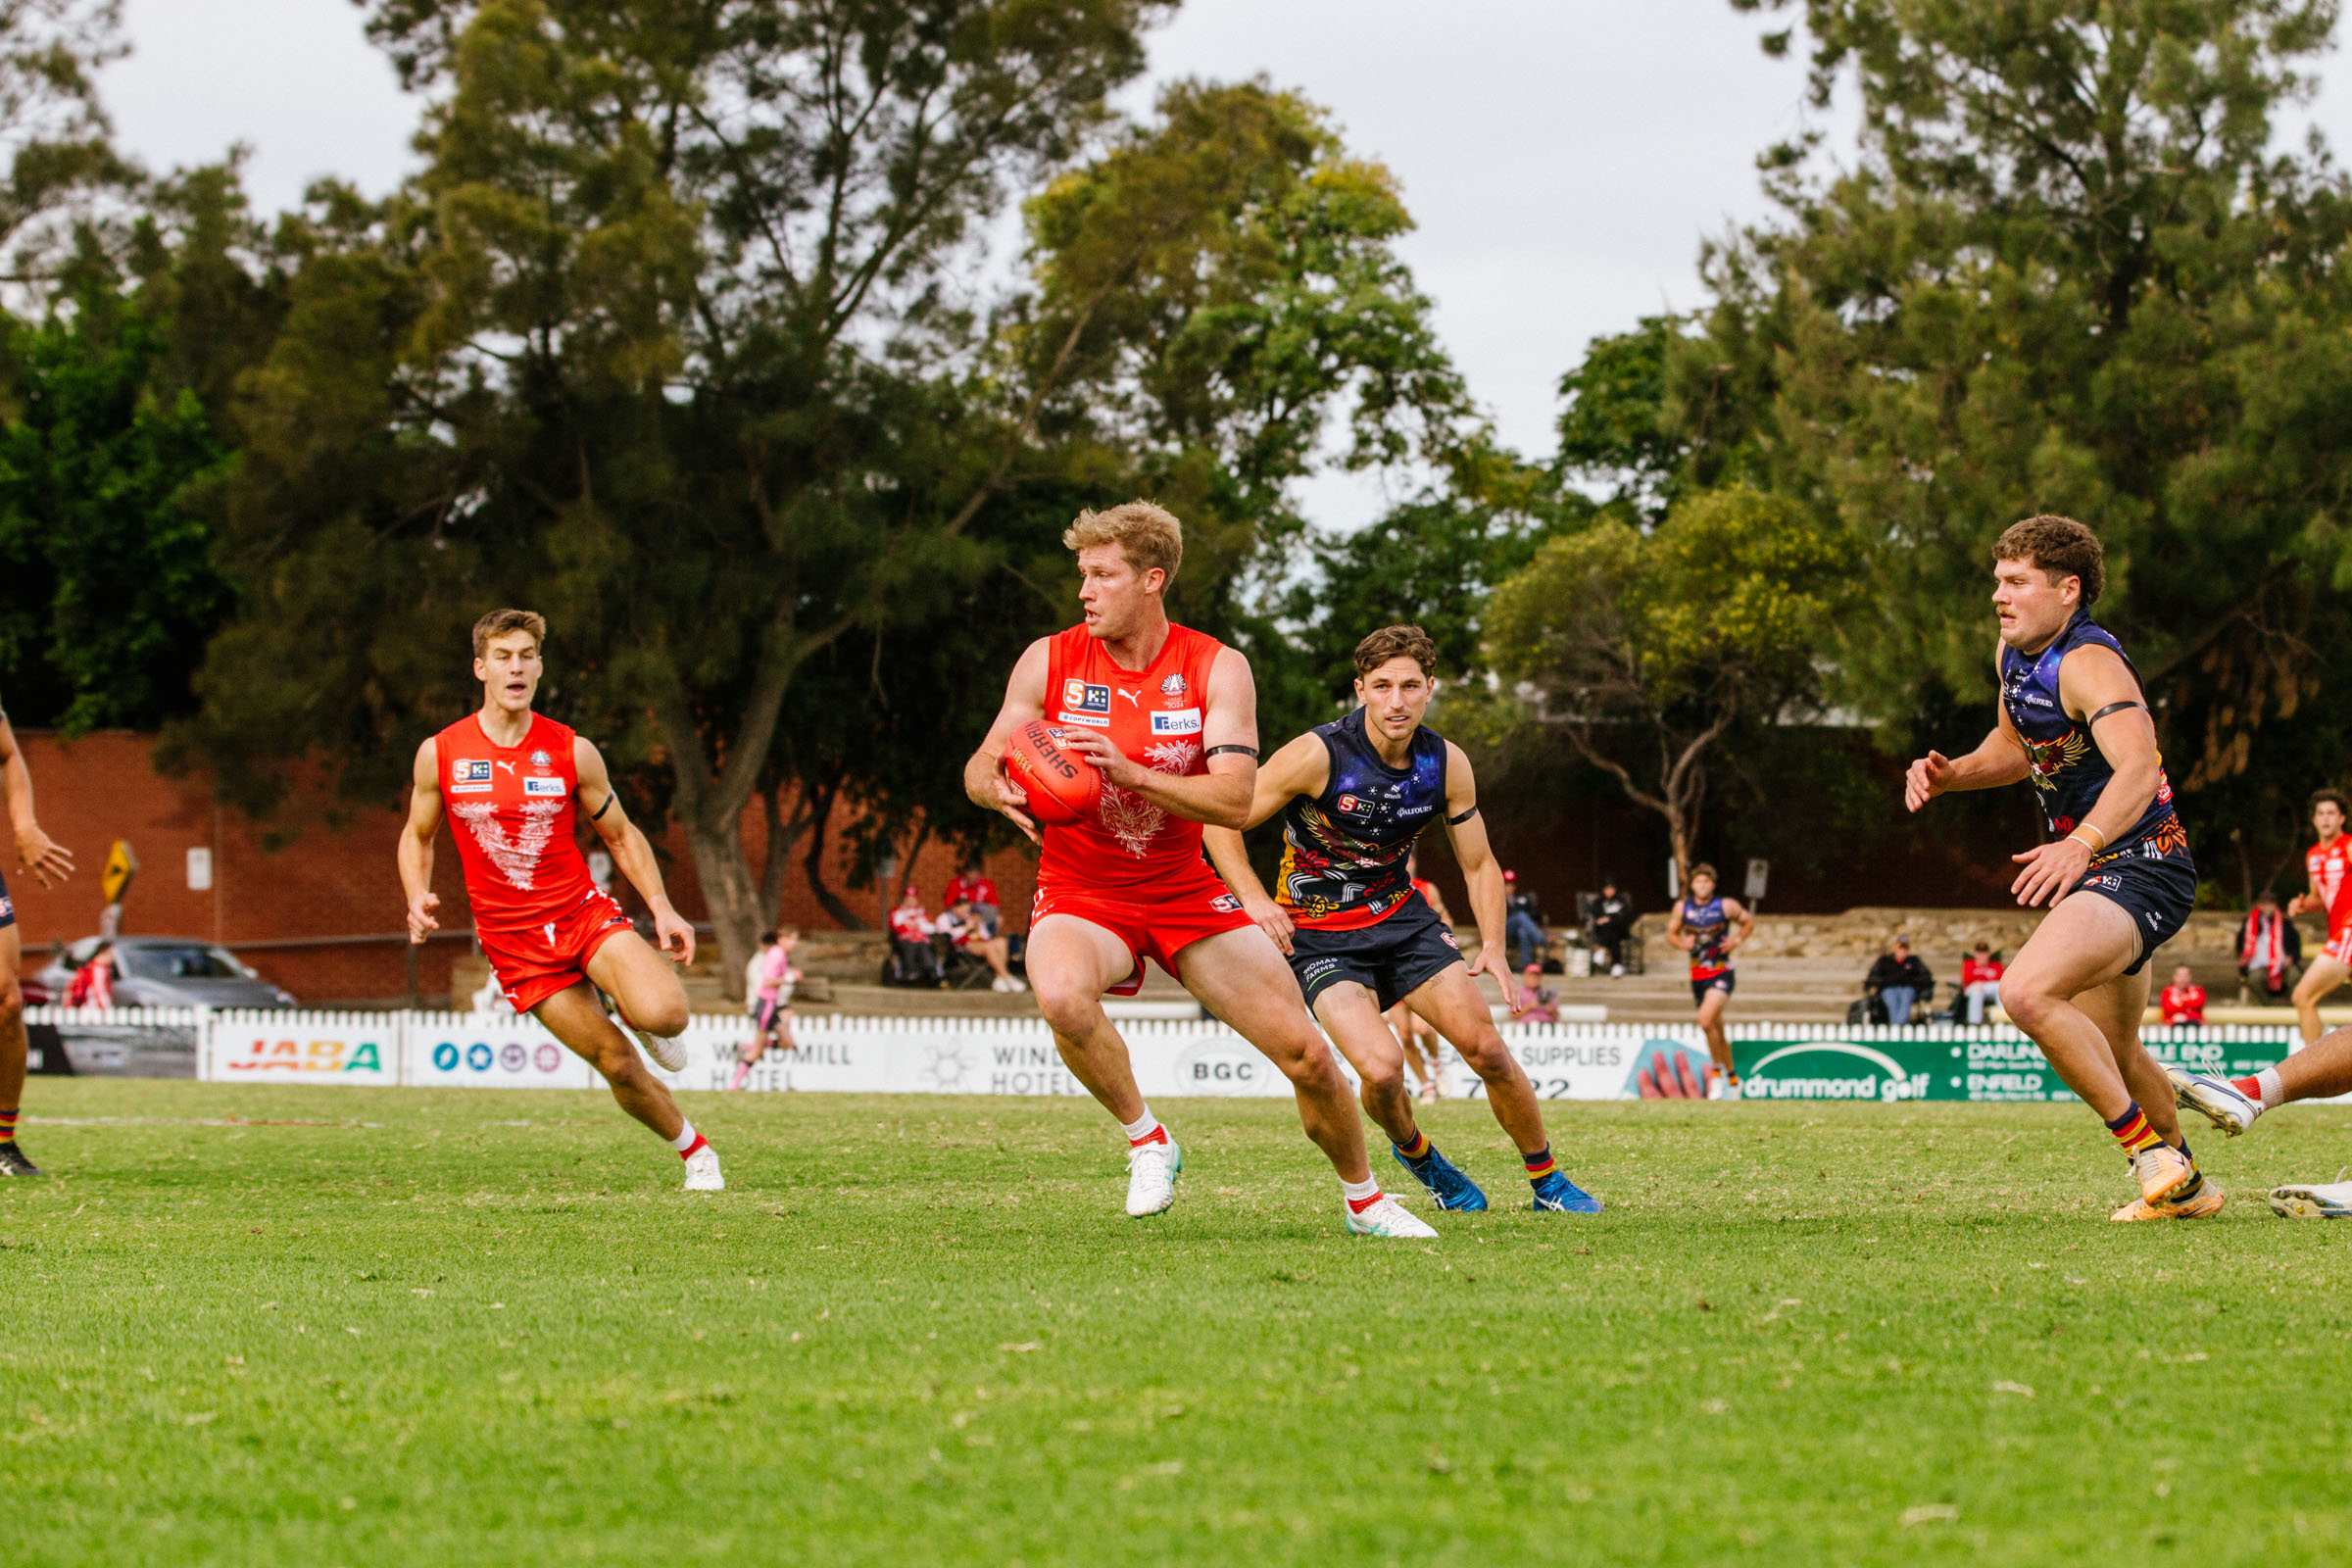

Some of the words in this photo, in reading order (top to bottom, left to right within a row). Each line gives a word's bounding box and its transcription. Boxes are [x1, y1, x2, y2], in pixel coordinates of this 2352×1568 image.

[1069, 715, 1108, 725] COPYWORLD
[228, 1040, 381, 1072] JABA
[711, 1042, 852, 1065] WDMILL
[1521, 1046, 1621, 1067] SUPPLIES
[1967, 1042, 2047, 1060] DARLIN
[1192, 1062, 1253, 1081] BGC
[1743, 1073, 1876, 1099] drummond
[1880, 1072, 1931, 1103] golf
